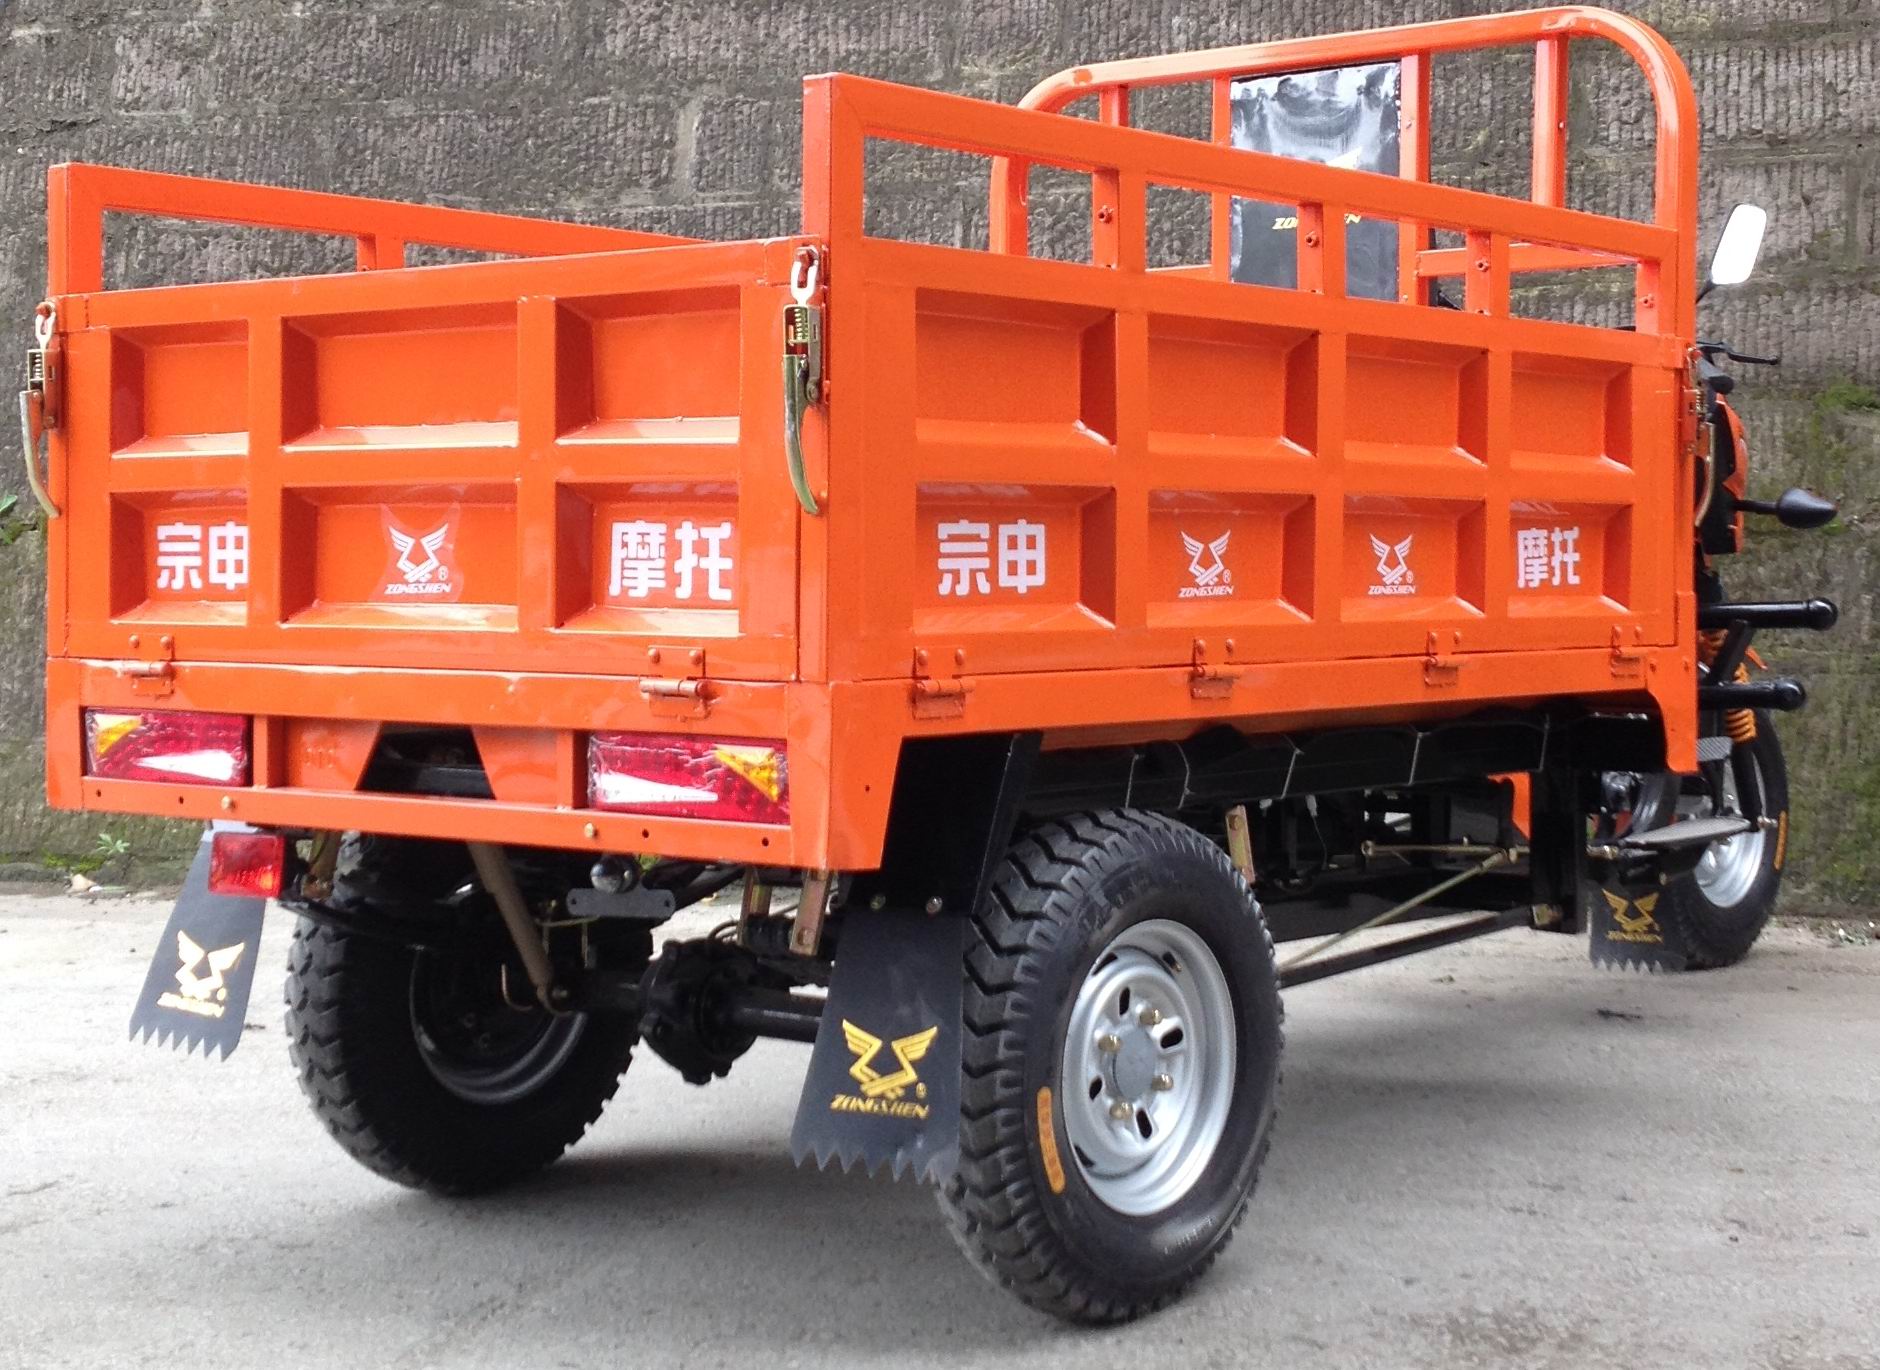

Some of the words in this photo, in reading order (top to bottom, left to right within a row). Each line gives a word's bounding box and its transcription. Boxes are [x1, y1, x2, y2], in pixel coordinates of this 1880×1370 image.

[157, 521, 249, 591] 宗申
[608, 520, 733, 600] 摩托
[937, 519, 1046, 596] 宗申
[1517, 526, 1581, 589] 摩托
[384, 582, 452, 595] ZONGSHEN
[1178, 585, 1234, 598] ZONGSHEN
[1367, 585, 1416, 596] ZONGSHEN
